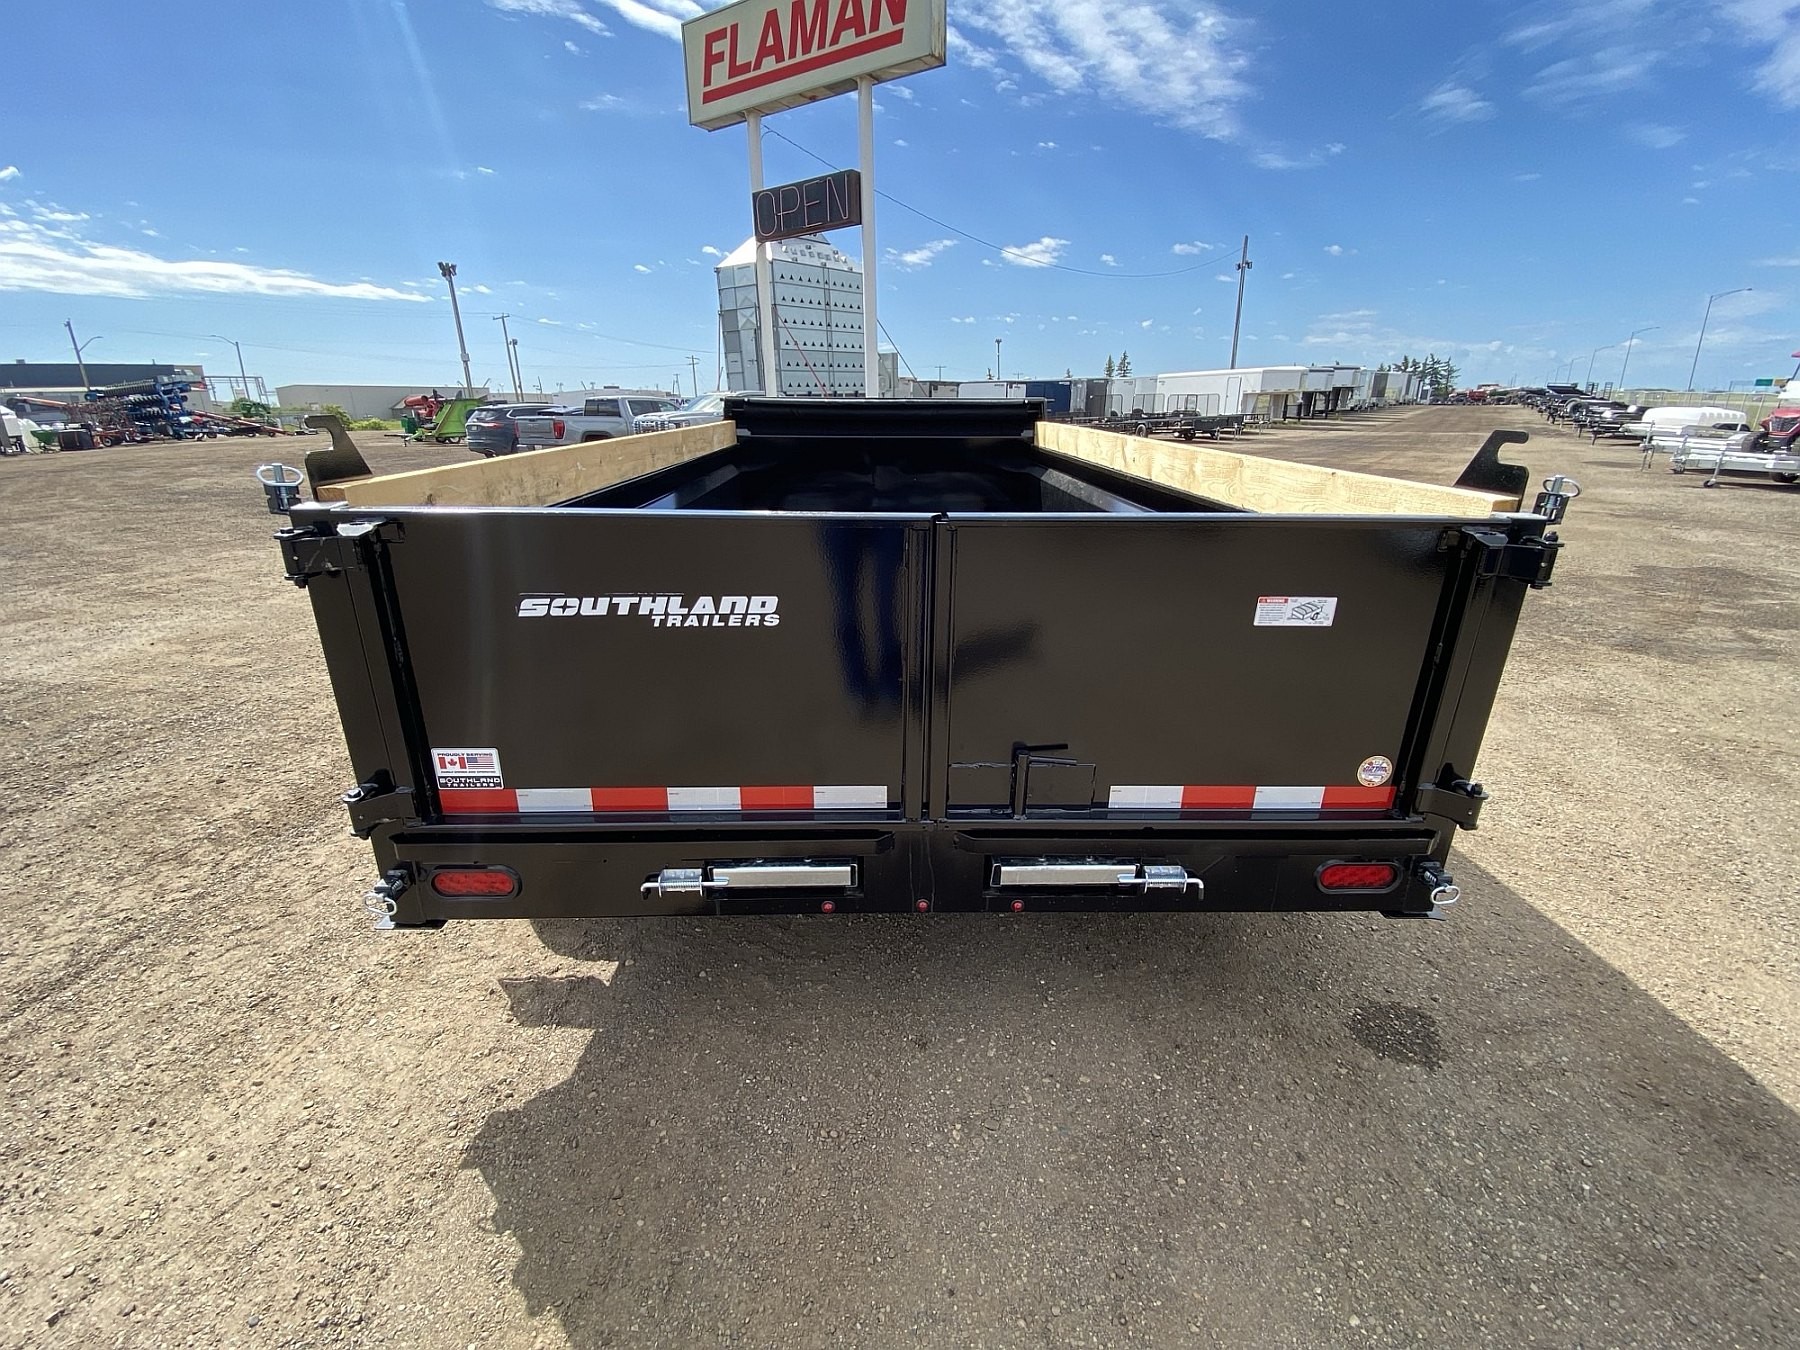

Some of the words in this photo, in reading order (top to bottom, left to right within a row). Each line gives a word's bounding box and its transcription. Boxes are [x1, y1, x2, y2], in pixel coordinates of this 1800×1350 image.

[703, 0, 908, 88] FLAMAN
[756, 173, 849, 237] OPEN
[518, 595, 779, 617] SOUTHLAND
[650, 614, 780, 627] TRAILERS
